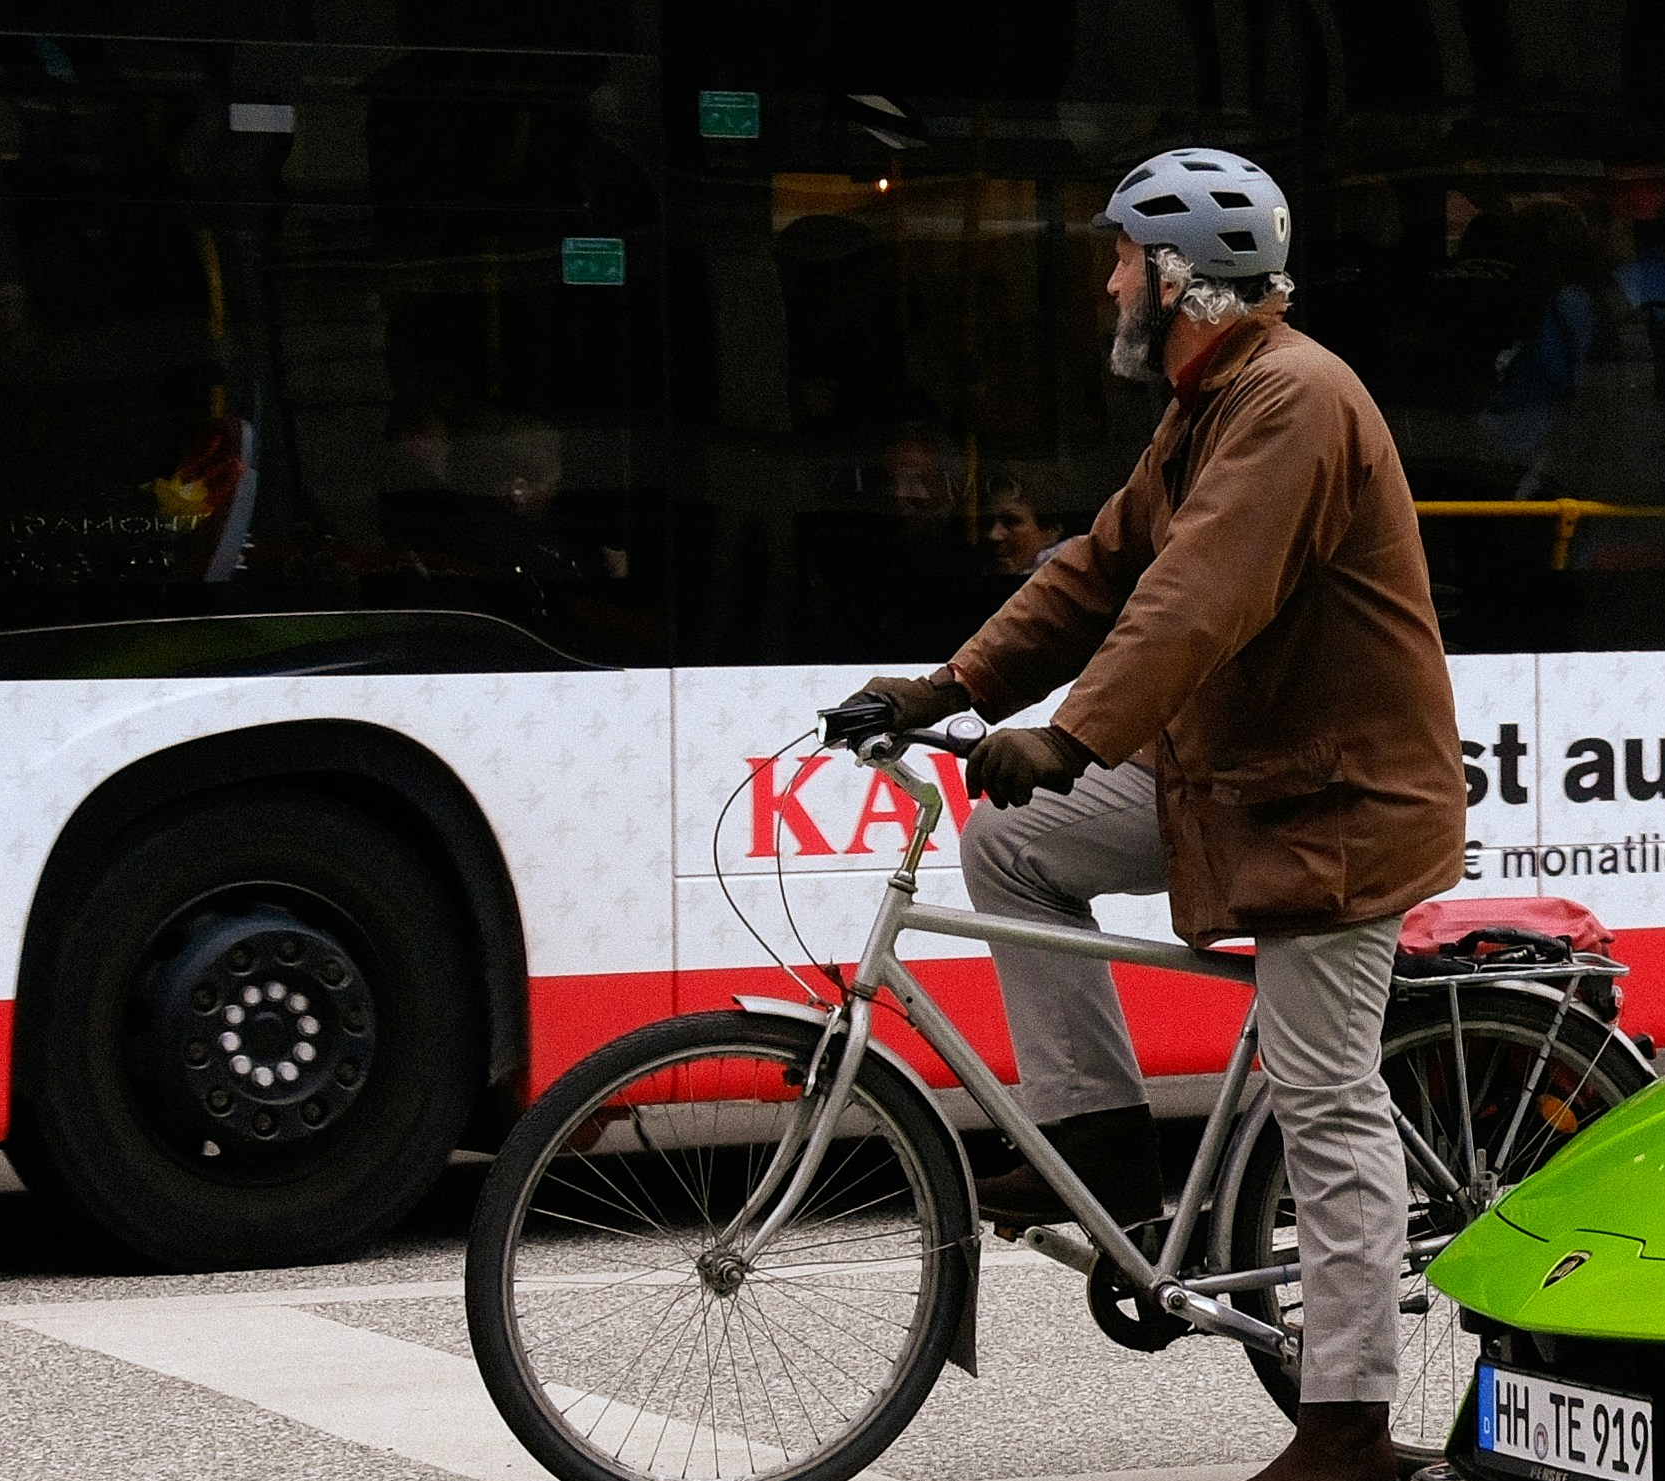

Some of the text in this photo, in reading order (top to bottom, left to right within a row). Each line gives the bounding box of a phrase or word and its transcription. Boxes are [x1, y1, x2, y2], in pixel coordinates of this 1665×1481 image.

[1461, 723, 1529, 809] st
[1495, 1379, 1650, 1476] HH TE 919
